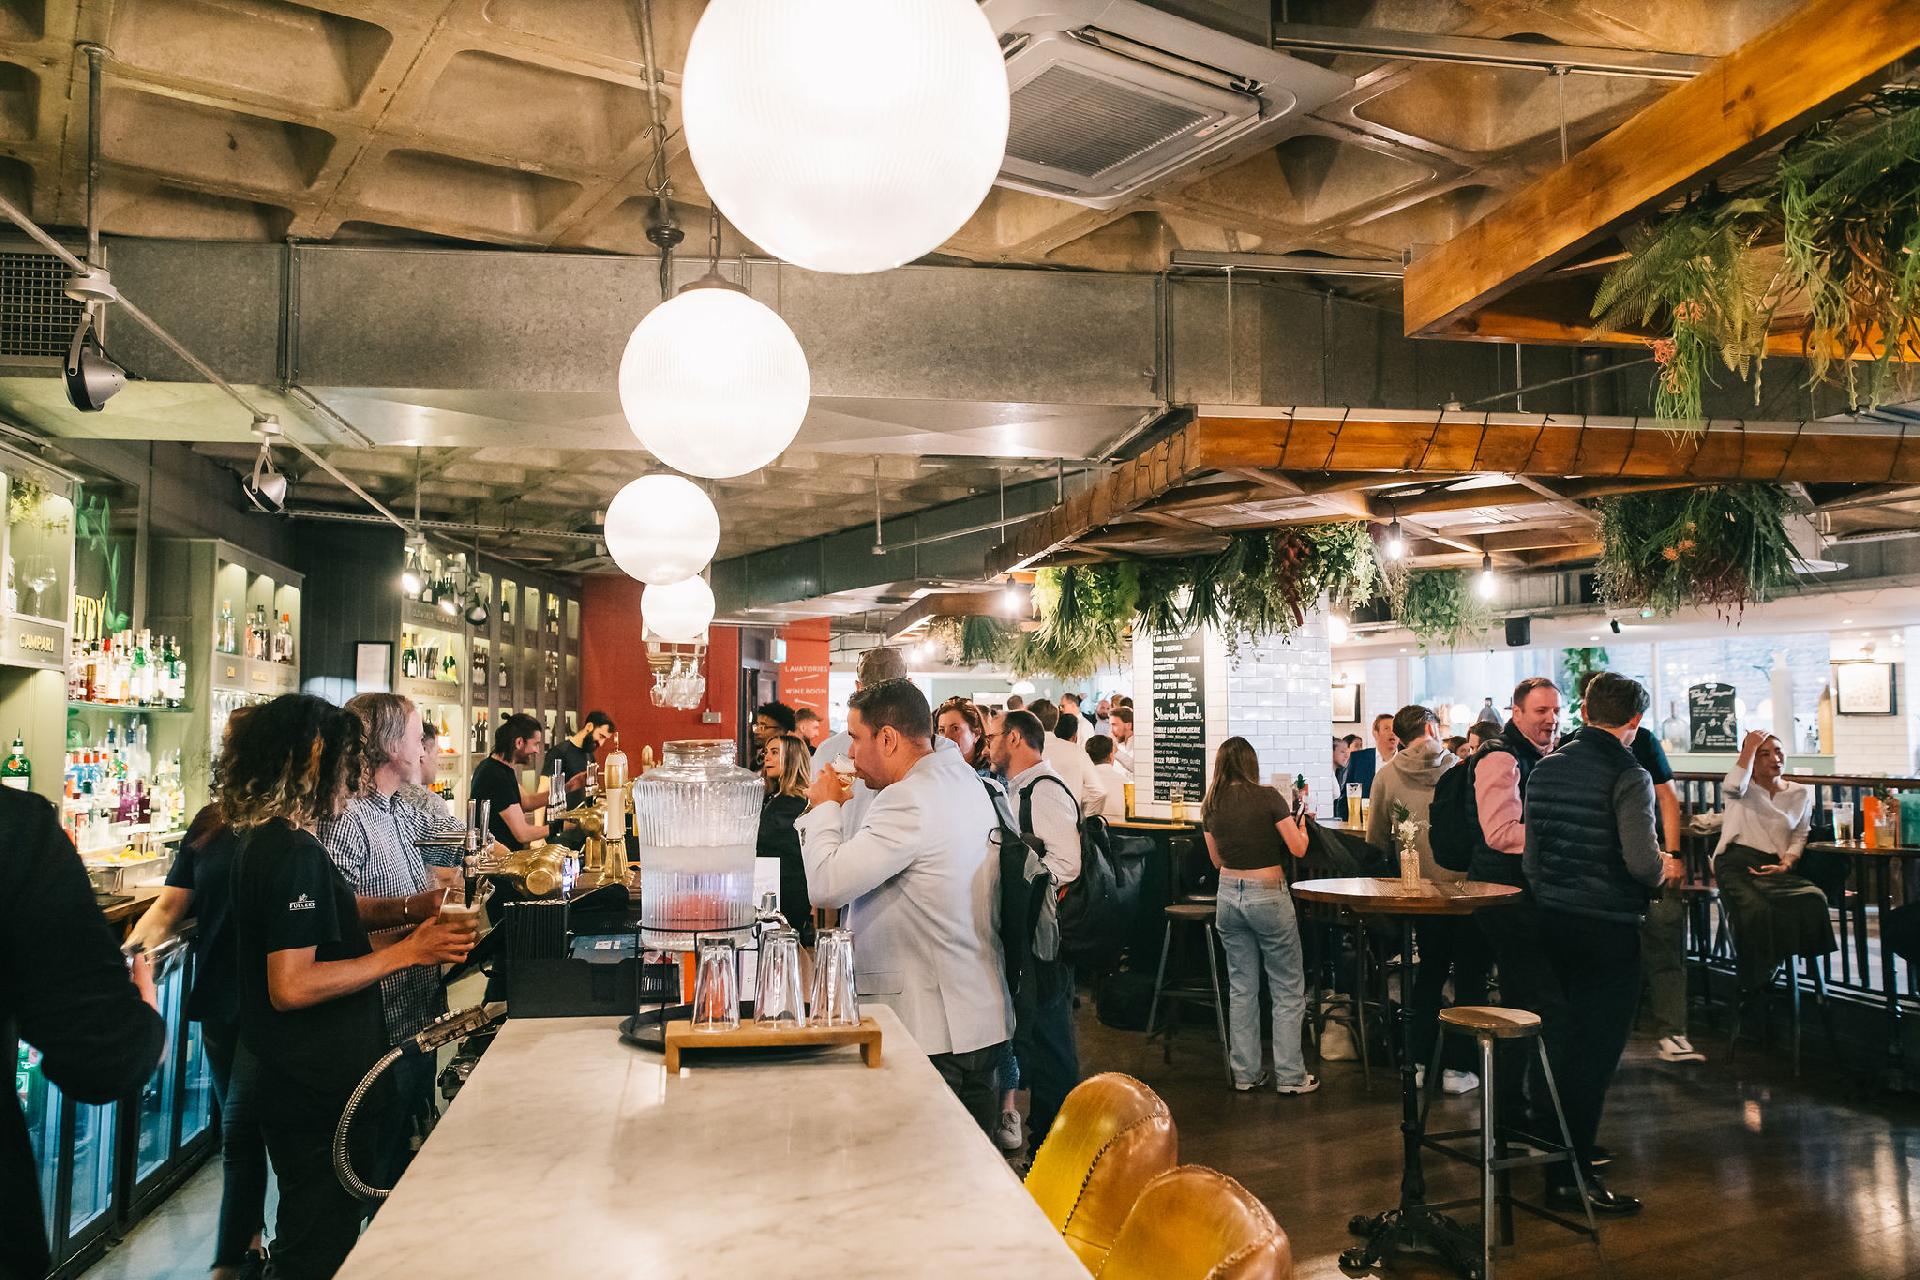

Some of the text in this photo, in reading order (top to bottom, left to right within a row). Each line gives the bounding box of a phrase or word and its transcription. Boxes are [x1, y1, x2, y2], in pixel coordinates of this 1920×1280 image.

[73, 591, 107, 641] TRY
[19, 633, 54, 652] CAMPARI
[1155, 706, 1201, 721] Sharing Boards
